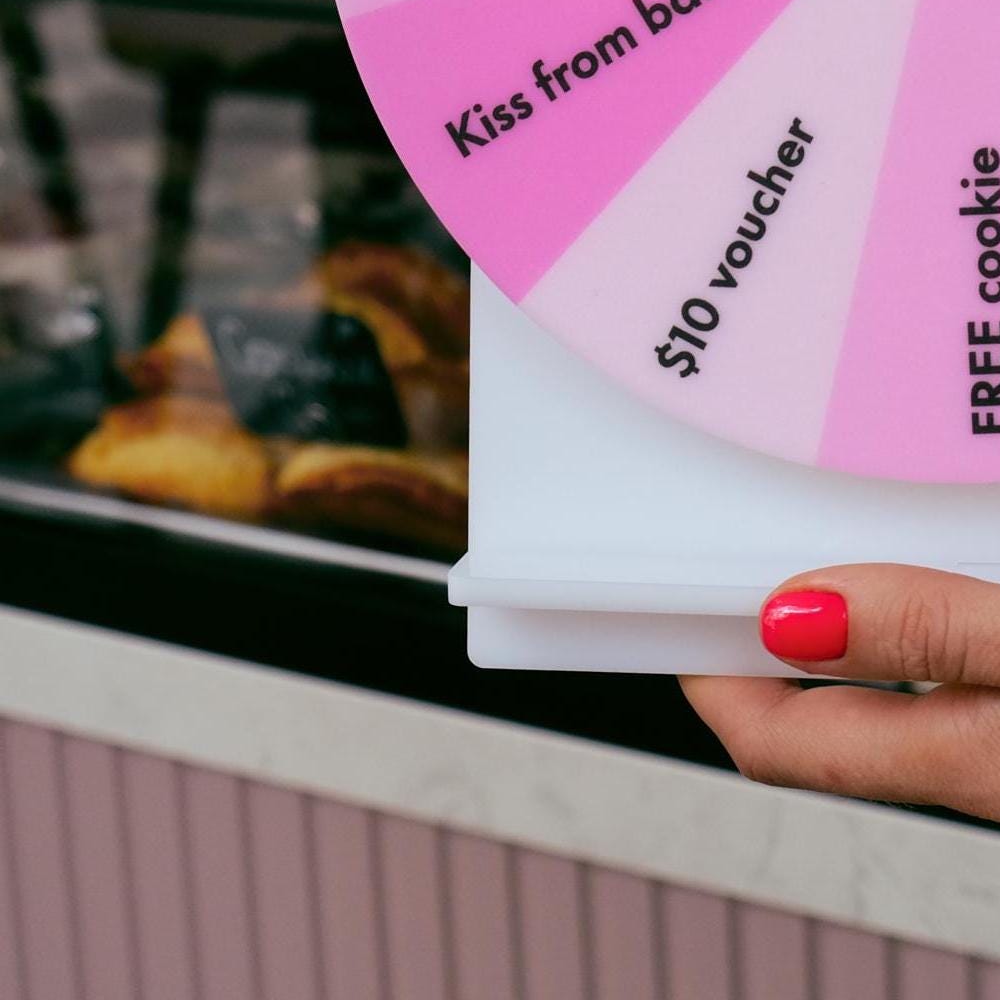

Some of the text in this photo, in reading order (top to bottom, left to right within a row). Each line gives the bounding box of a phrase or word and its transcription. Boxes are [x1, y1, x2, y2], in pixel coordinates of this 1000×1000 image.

[445, 93, 533, 157] Kiss
[533, 27, 638, 101] from
[655, 118, 813, 378] $10 voucher
